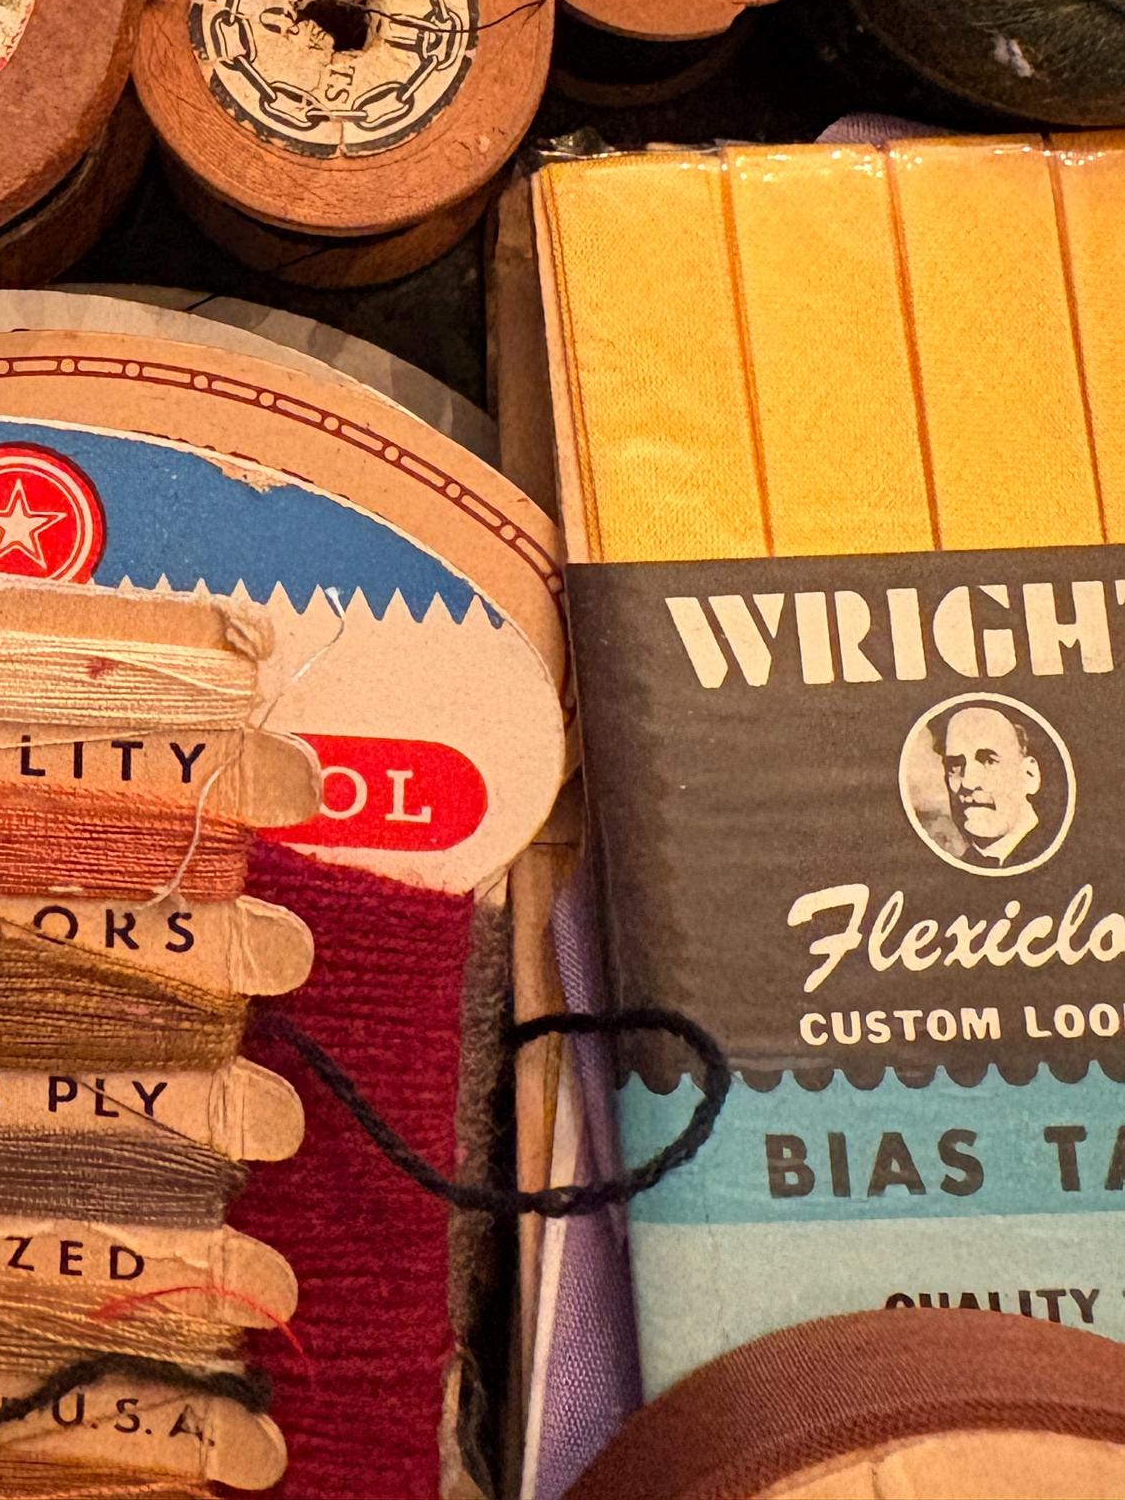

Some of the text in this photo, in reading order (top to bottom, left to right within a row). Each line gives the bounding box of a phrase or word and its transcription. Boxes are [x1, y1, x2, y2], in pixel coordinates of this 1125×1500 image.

[665, 579, 1125, 689] WRIGH
[800, 1003, 1125, 1046] CUSTOM LOO
[48, 1075, 168, 1117] PLY
[765, 1128, 985, 1199] BIAS
